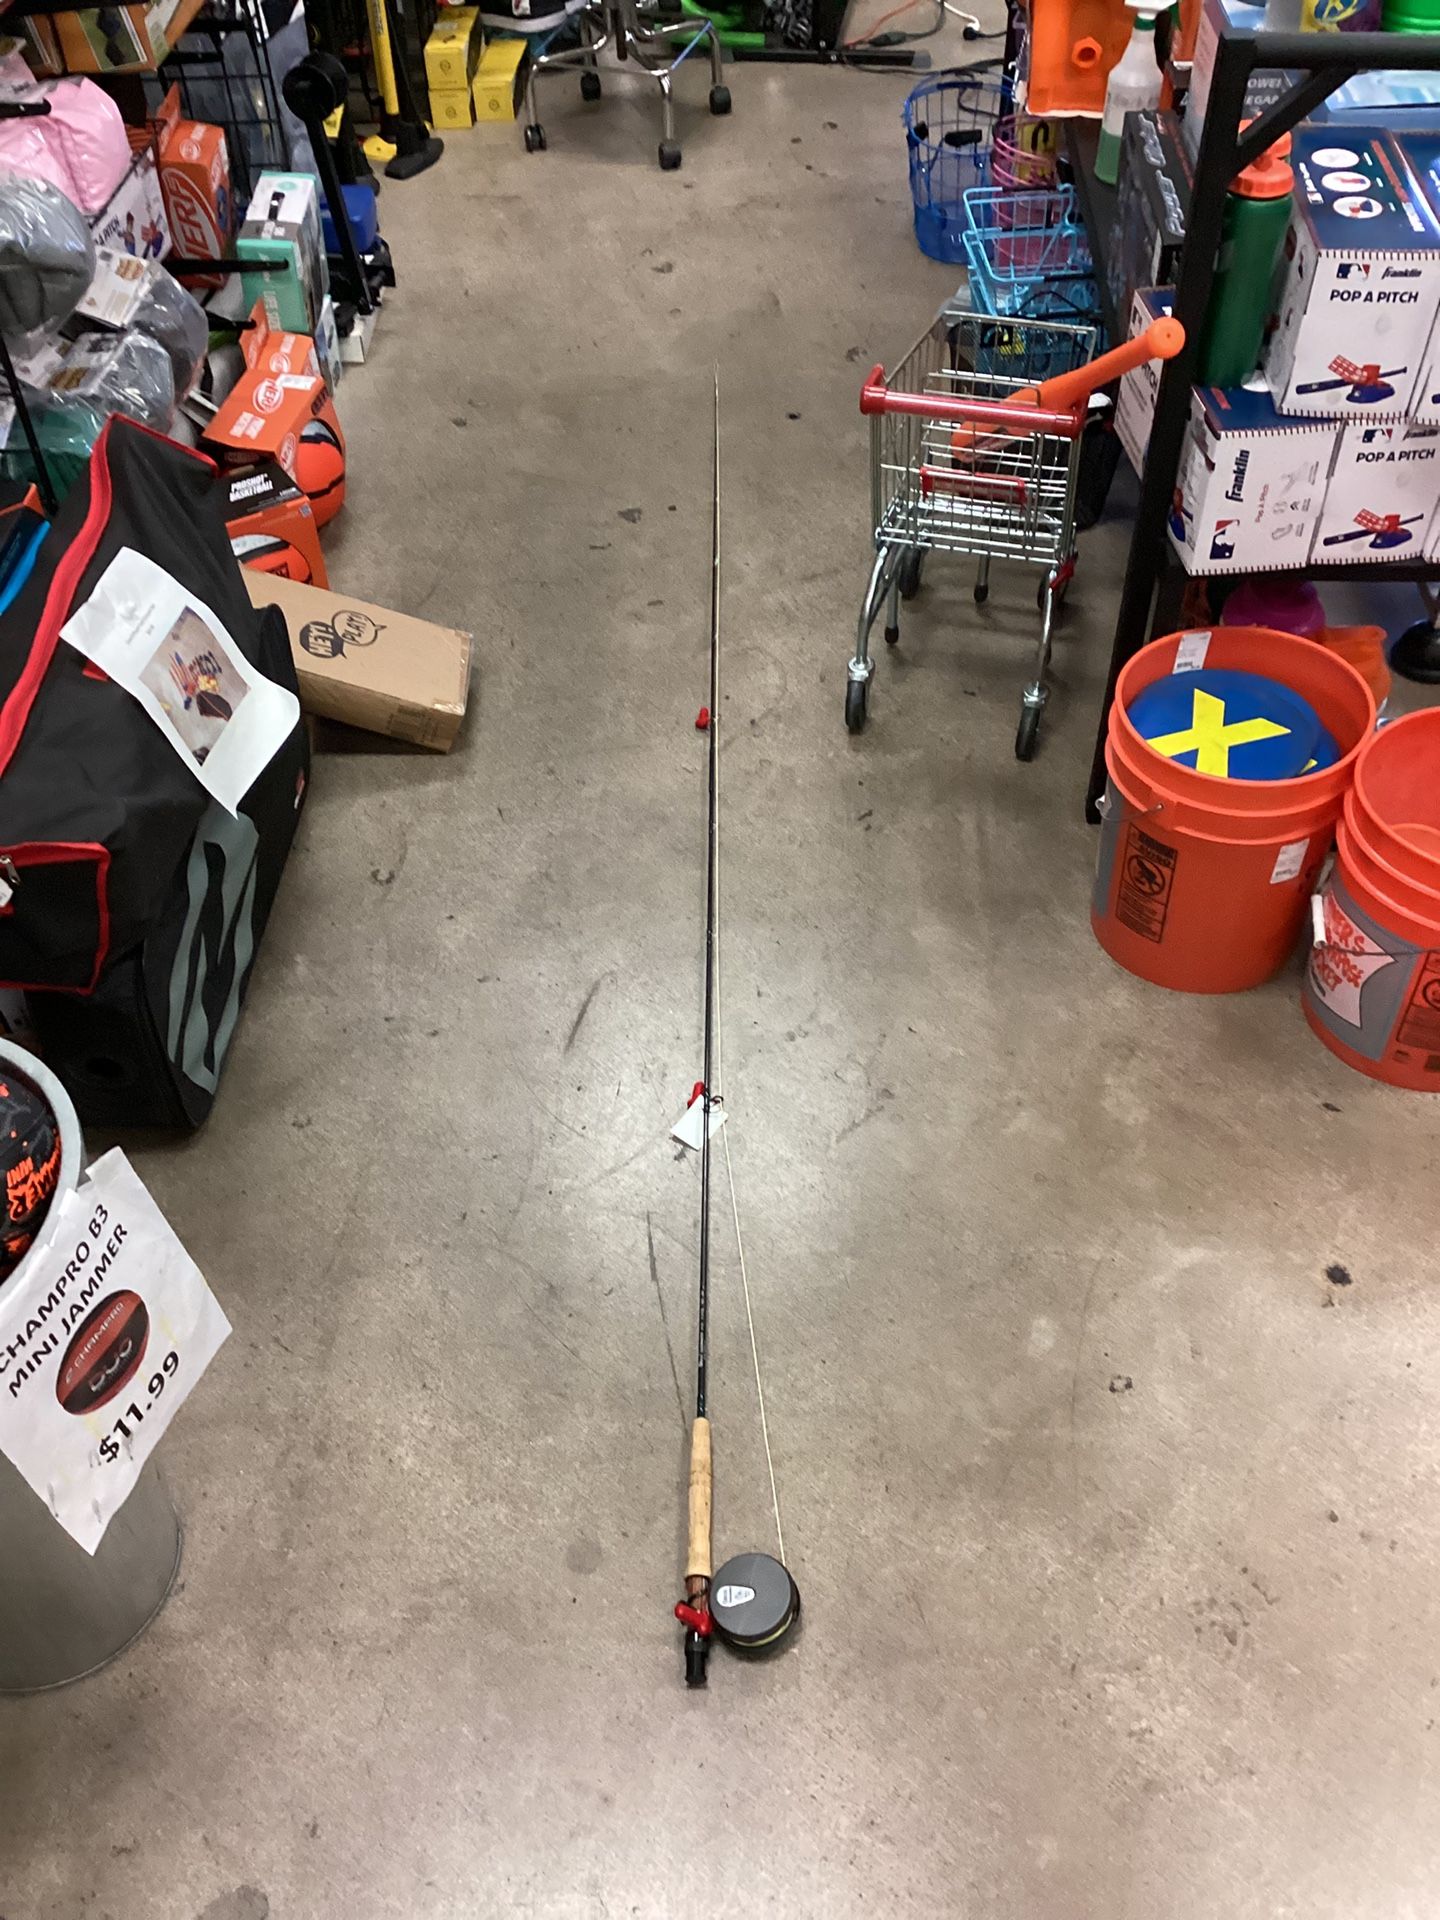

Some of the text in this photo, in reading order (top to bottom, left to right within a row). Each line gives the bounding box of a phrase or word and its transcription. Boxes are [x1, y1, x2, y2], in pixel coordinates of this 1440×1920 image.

[1329, 289, 1419, 304] POP A PITCH
[1355, 449, 1435, 463] POP A PITCH
[229, 480, 273, 502] BASKETBALL
[89, 1203, 110, 1239] B3
[8, 1224, 128, 1398] MINI JAMMER
[75, 1301, 125, 1368] CHAMPRO
[99, 1350, 180, 1464] $11.99
